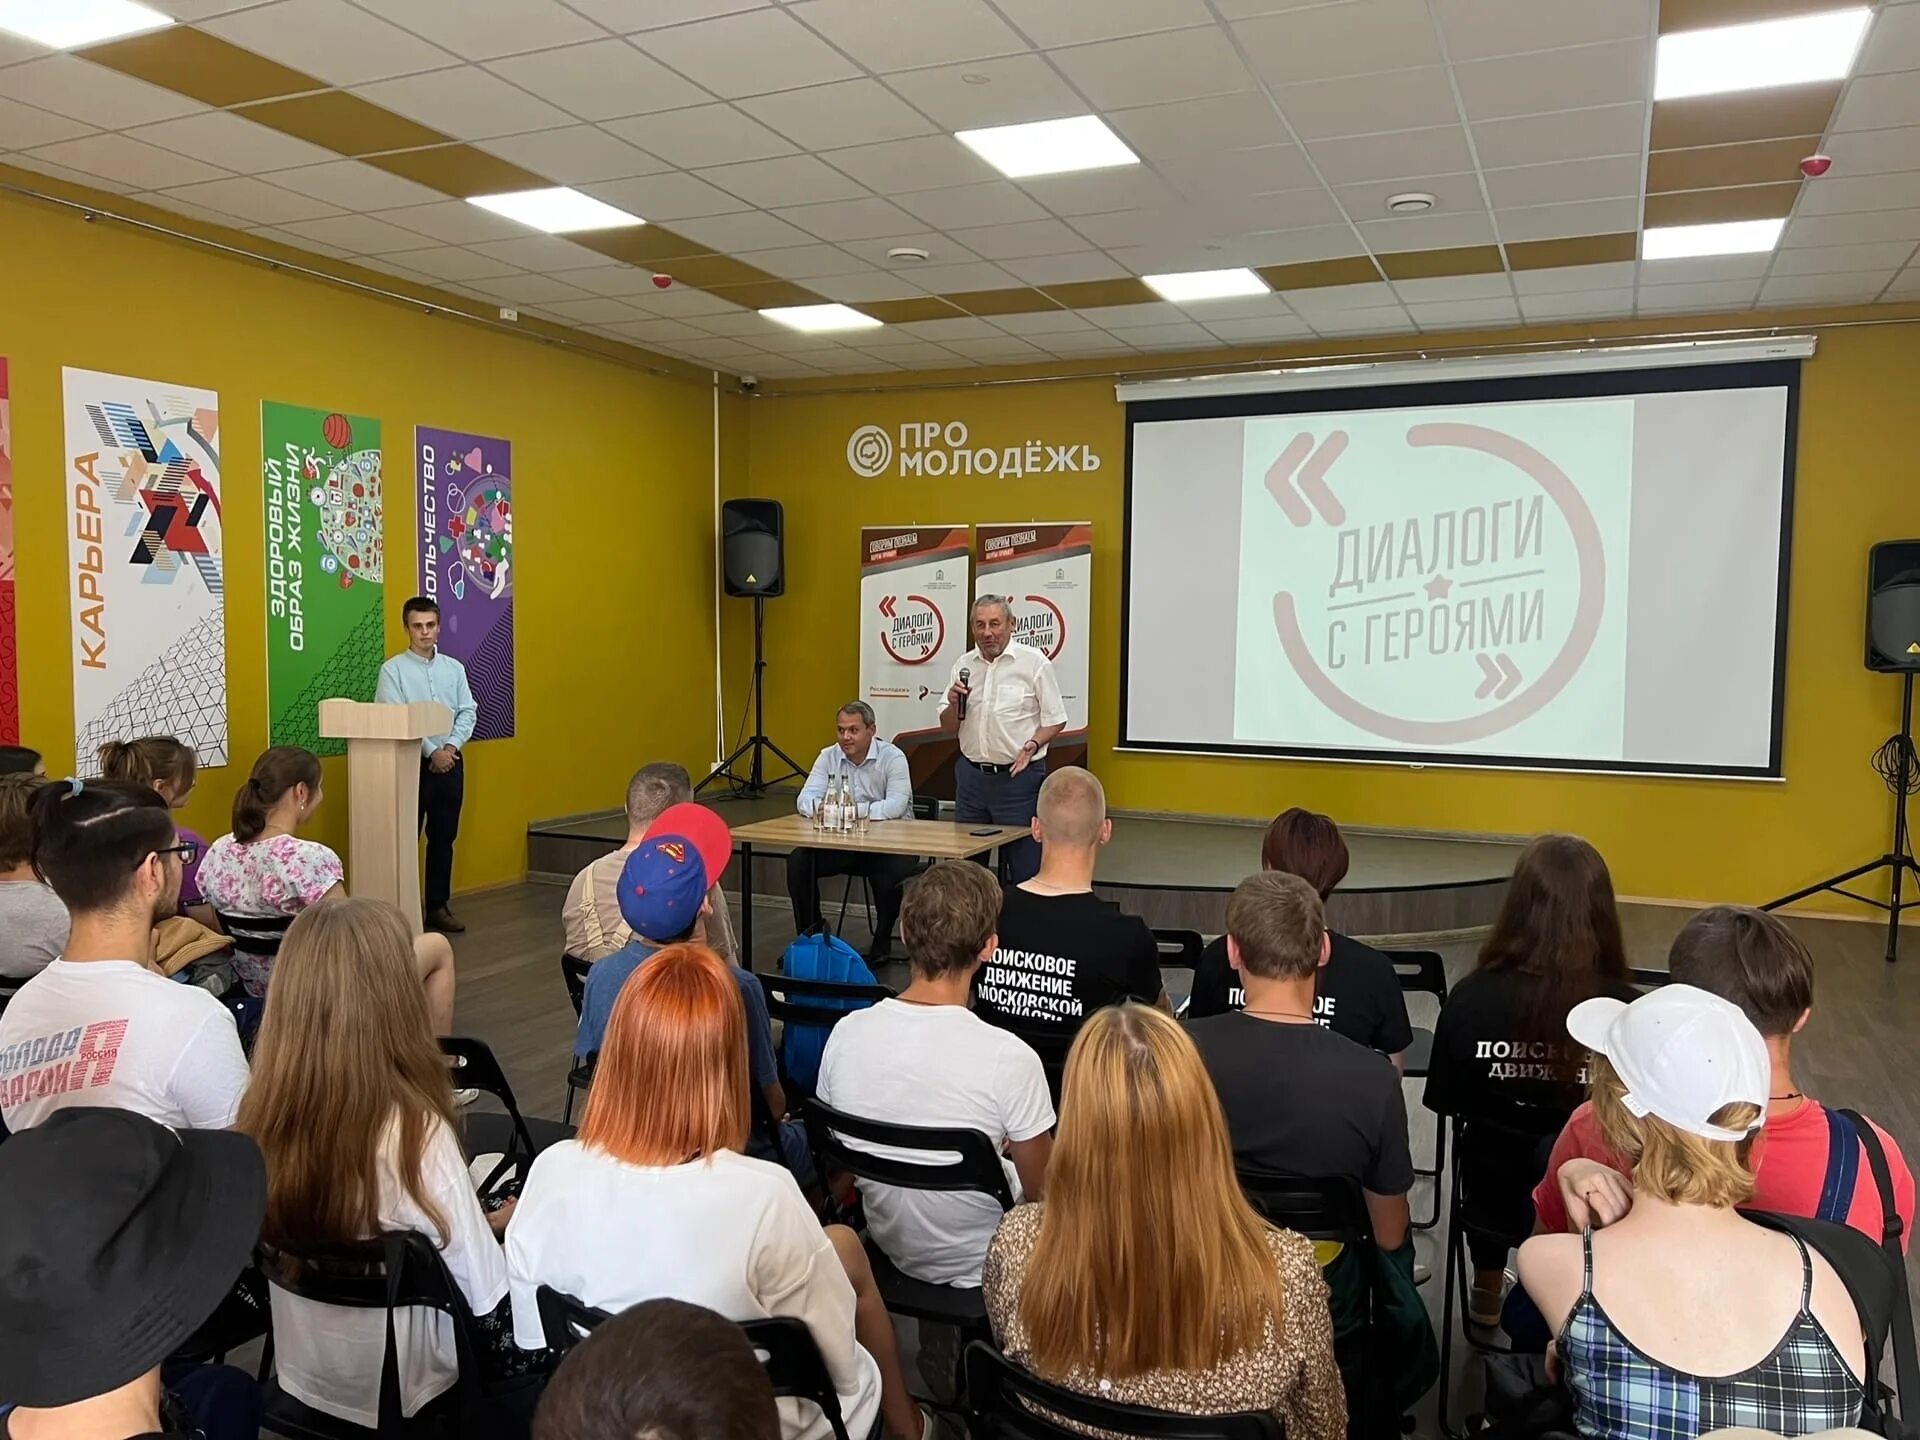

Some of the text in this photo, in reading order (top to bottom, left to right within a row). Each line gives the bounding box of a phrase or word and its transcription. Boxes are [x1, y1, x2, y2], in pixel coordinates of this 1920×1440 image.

[900, 421, 968, 448] ПРО
[900, 440, 1101, 478] МОЛОДЁЖЬ
[264, 457, 287, 618] ЗДОРОВЫЙ
[285, 442, 304, 651] ОБРАЗ ЖИЗНИ
[1329, 495, 1544, 598] ДИАЛОГИ
[74, 451, 107, 669] КАРЬЕРА
[892, 612, 932, 633] ДИАЛОГИ
[1328, 589, 1544, 669] С ГЕРОЯМИ
[892, 632, 933, 649] С ГЕРОЯМИ
[988, 947, 1077, 977] ОИСКОВОЕ
[984, 966, 1073, 997] ДВИЖЕНИЕ
[978, 982, 1083, 1017] МОСКОВСКОЙ
[80, 1048, 118, 1060] РОССИЯ
